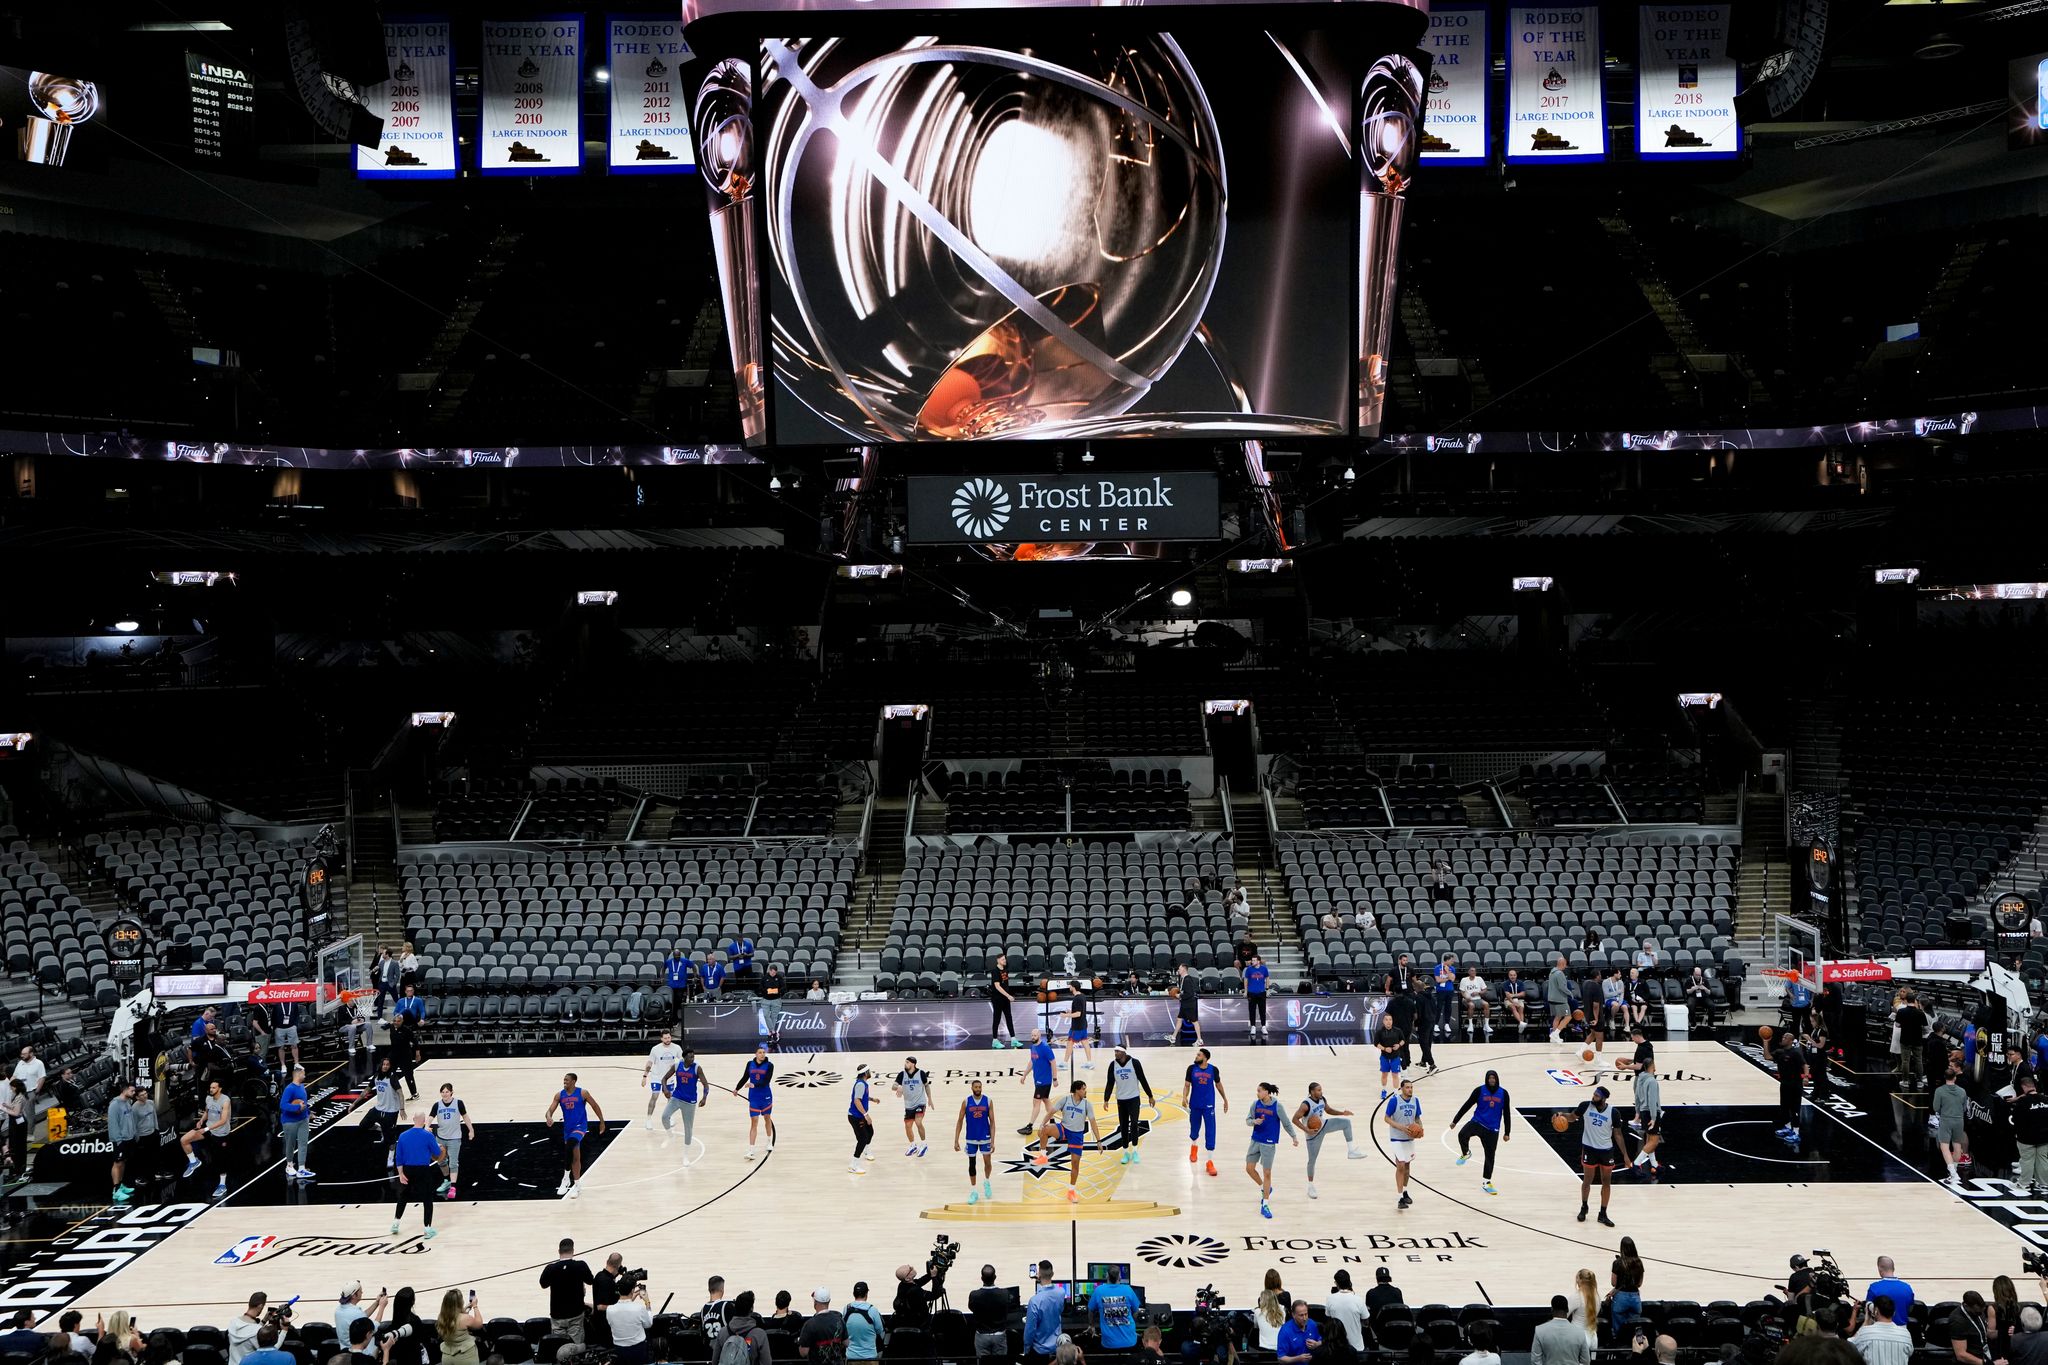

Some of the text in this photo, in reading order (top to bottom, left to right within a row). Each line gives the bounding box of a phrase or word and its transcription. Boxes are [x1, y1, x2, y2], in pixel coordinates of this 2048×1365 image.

[1431, 16, 1468, 27] DEO
[1526, 12, 1582, 24] RODEO
[385, 26, 448, 37] DEO OF
[486, 27, 576, 38] RODEO OF
[614, 25, 674, 36] RODEO
[1656, 29, 1721, 40] OF THE
[1432, 34, 1470, 46] THE
[1523, 31, 1586, 43] OF THE
[401, 45, 446, 58] YEAR
[487, 44, 575, 56] THE YEAR
[614, 43, 689, 54] THE YEA
[1665, 48, 1710, 60] YEAR
[1534, 50, 1576, 62] YEAR
[208, 65, 247, 81] NBA
[190, 73, 254, 88] DIVISION TITLES
[192, 86, 219, 97] 2005-06
[391, 86, 420, 96] 2005
[514, 83, 542, 94] 2008
[644, 82, 670, 92] 2011
[192, 97, 220, 107] 2008-09
[228, 93, 252, 102] 2016-17
[644, 98, 670, 108] 2012
[1541, 96, 1568, 108] 2017
[1674, 94, 1702, 104] 2018
[227, 103, 252, 112] 2025-26
[392, 102, 420, 112] 2006
[514, 98, 543, 109] 2009
[1426, 99, 1450, 110] 2016
[194, 107, 220, 116] 2010-11
[1552, 112, 1594, 120] INDOOR
[1648, 108, 1728, 118] LARGE INDOOR
[194, 117, 220, 127] 2011-12
[392, 116, 420, 127] 2007
[515, 114, 542, 124] 2010
[644, 112, 670, 123] 2013
[194, 127, 220, 138] 2012-13
[194, 148, 221, 157] 2015-16
[1922, 418, 1957, 437] Finals
[1432, 439, 1464, 452] Finals
[1628, 435, 1660, 451] Finals
[176, 444, 209, 461] Finals
[470, 449, 500, 466] Finals
[670, 449, 700, 465] Finals
[1018, 476, 1173, 509] Frost Bank
[1040, 518, 1148, 532] CENTER
[1515, 520, 1528, 528] 109
[1247, 562, 1270, 572] Finals
[179, 572, 205, 584] Finals
[857, 568, 880, 578] Finals
[1882, 572, 1905, 582] Finals
[1519, 581, 1540, 590] Finals
[2003, 585, 2034, 599] Finals
[1683, 697, 1707, 708] Finals
[891, 708, 913, 720] Finals
[1212, 704, 1235, 715] Finals
[419, 714, 442, 726] Finals
[2001, 903, 2024, 912] 13:42
[115, 931, 140, 940] 13:42
[1296, 1003, 1356, 1031] Finals
[776, 1011, 827, 1041] Finals
[1992, 1033, 2002, 1042] GET
[1992, 1043, 2002, 1052] THE
[138, 1058, 150, 1067] GET
[1994, 1053, 2005, 1064] App
[138, 1068, 150, 1076] THE
[945, 1067, 1025, 1078] Bank
[141, 1078, 152, 1088] App
[1968, 1100, 1992, 1124] Finals
[60, 1139, 114, 1154] coinba
[1240, 1232, 1488, 1250] Frost Bank
[224, 1234, 432, 1267] Finals
[1280, 1255, 1454, 1264] CENTER
